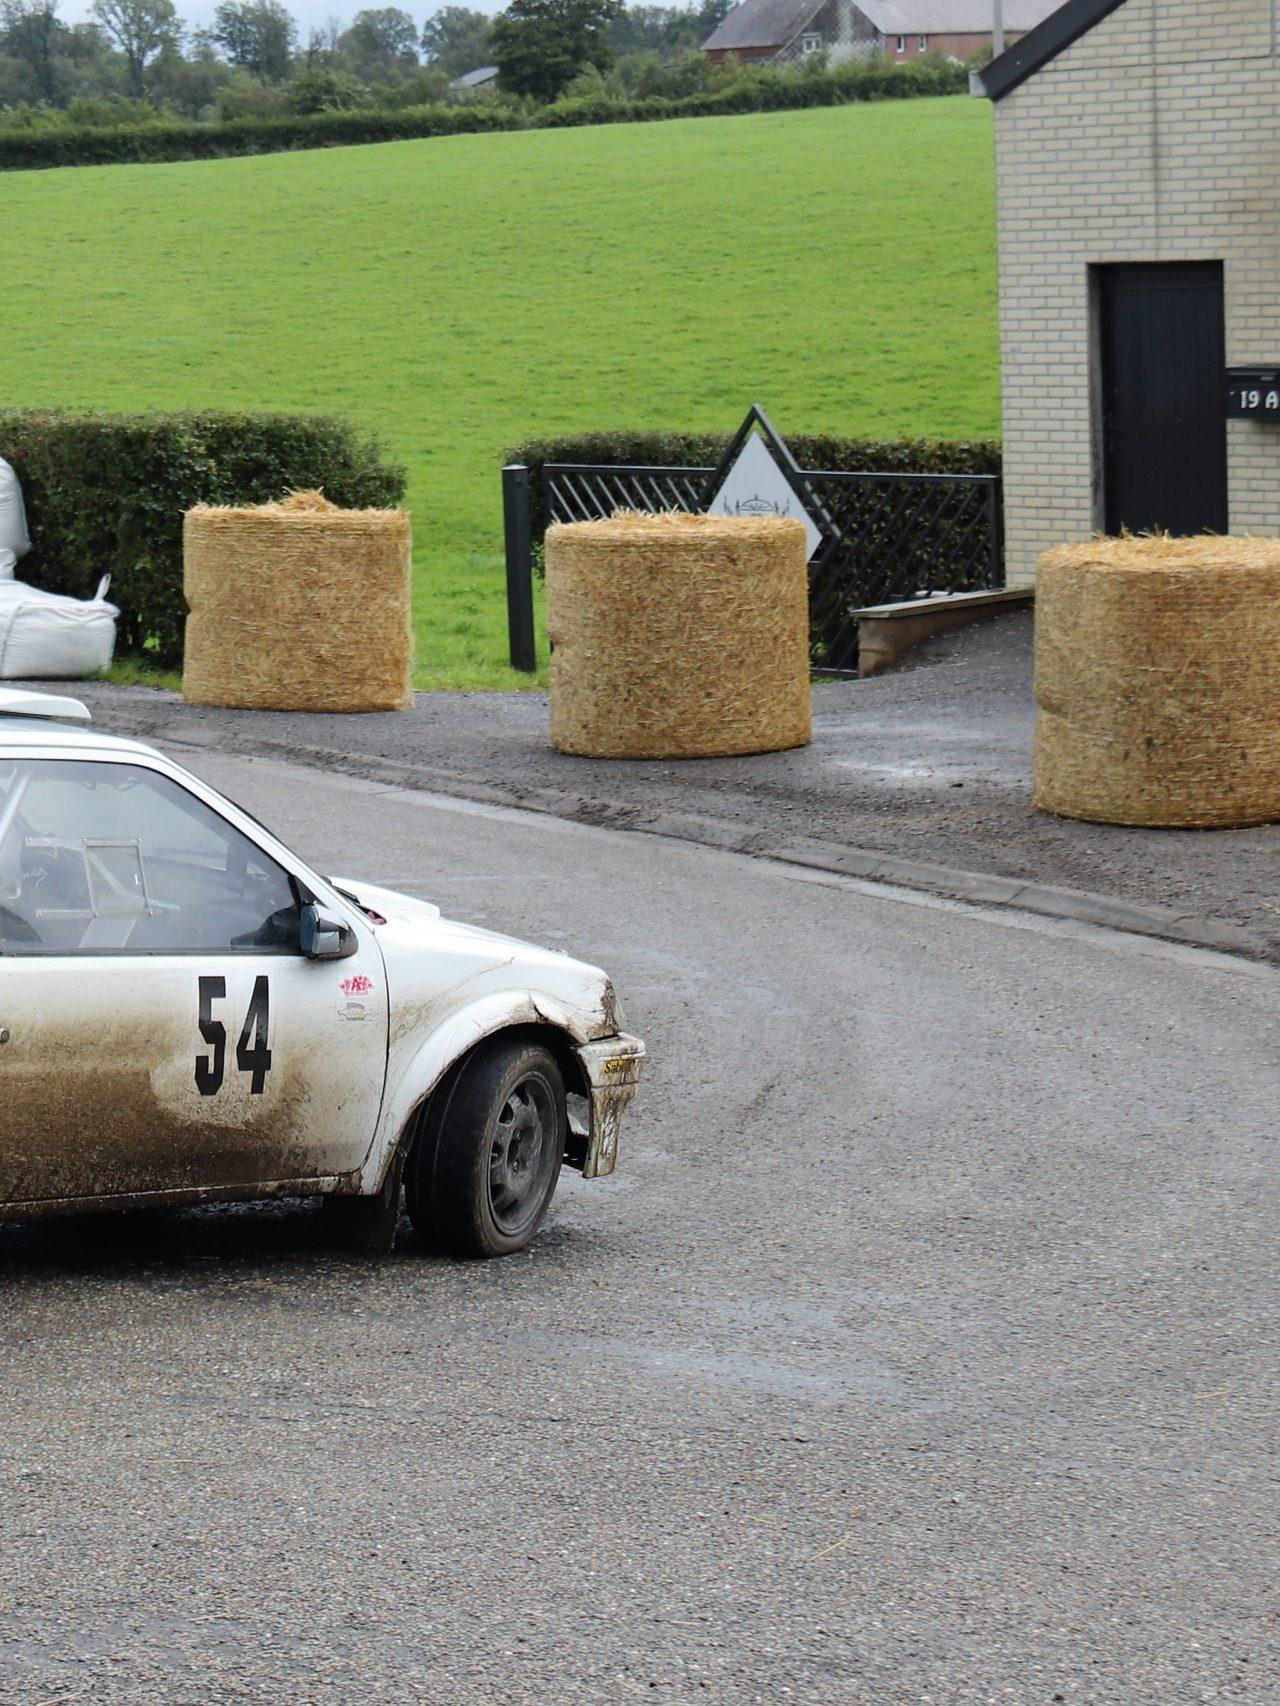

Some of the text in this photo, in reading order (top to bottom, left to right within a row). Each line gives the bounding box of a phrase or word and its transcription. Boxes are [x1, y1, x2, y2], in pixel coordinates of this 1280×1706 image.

[1240, 390, 1279, 409] 19 A
[194, 974, 272, 1096] 54
